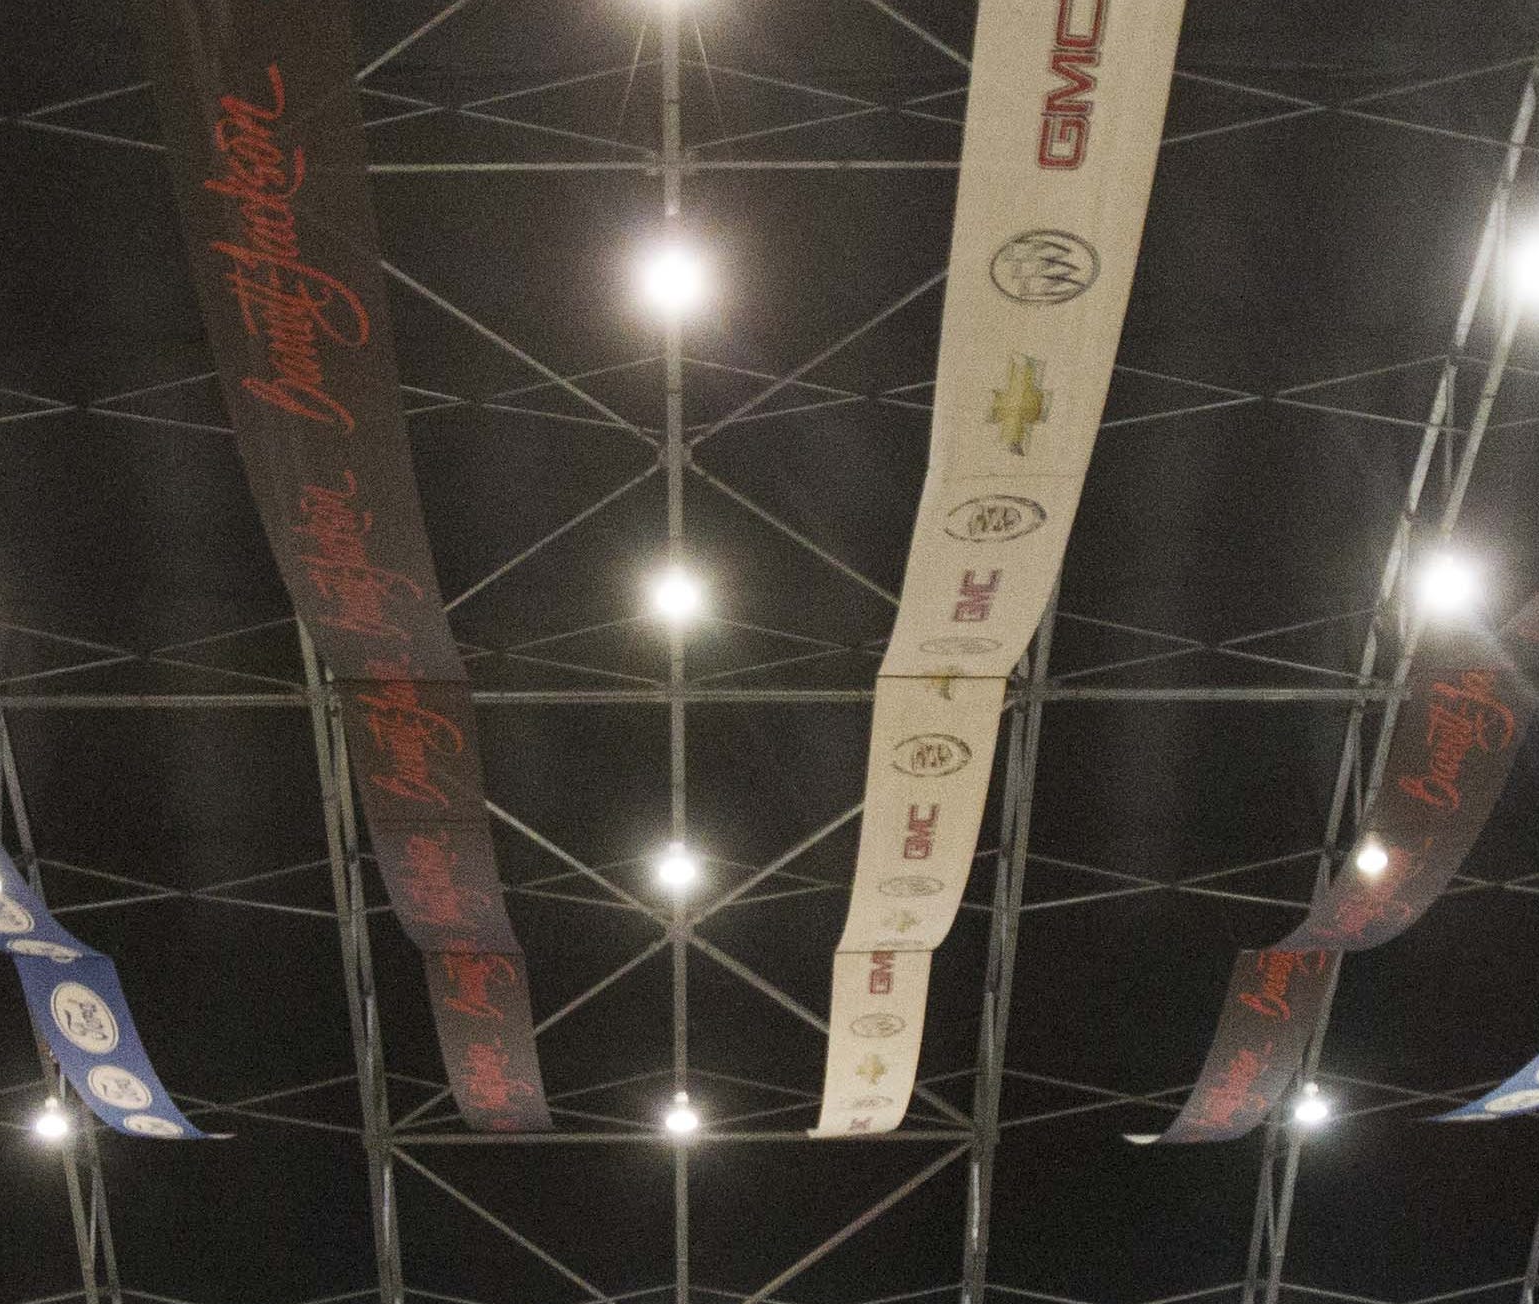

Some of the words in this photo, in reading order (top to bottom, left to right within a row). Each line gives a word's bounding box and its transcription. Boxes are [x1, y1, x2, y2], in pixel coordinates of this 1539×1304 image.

[1038, 0, 1108, 170] GMC
[952, 569, 1002, 622] GMC
[903, 804, 939, 859] GMC
[869, 951, 895, 994] GM
